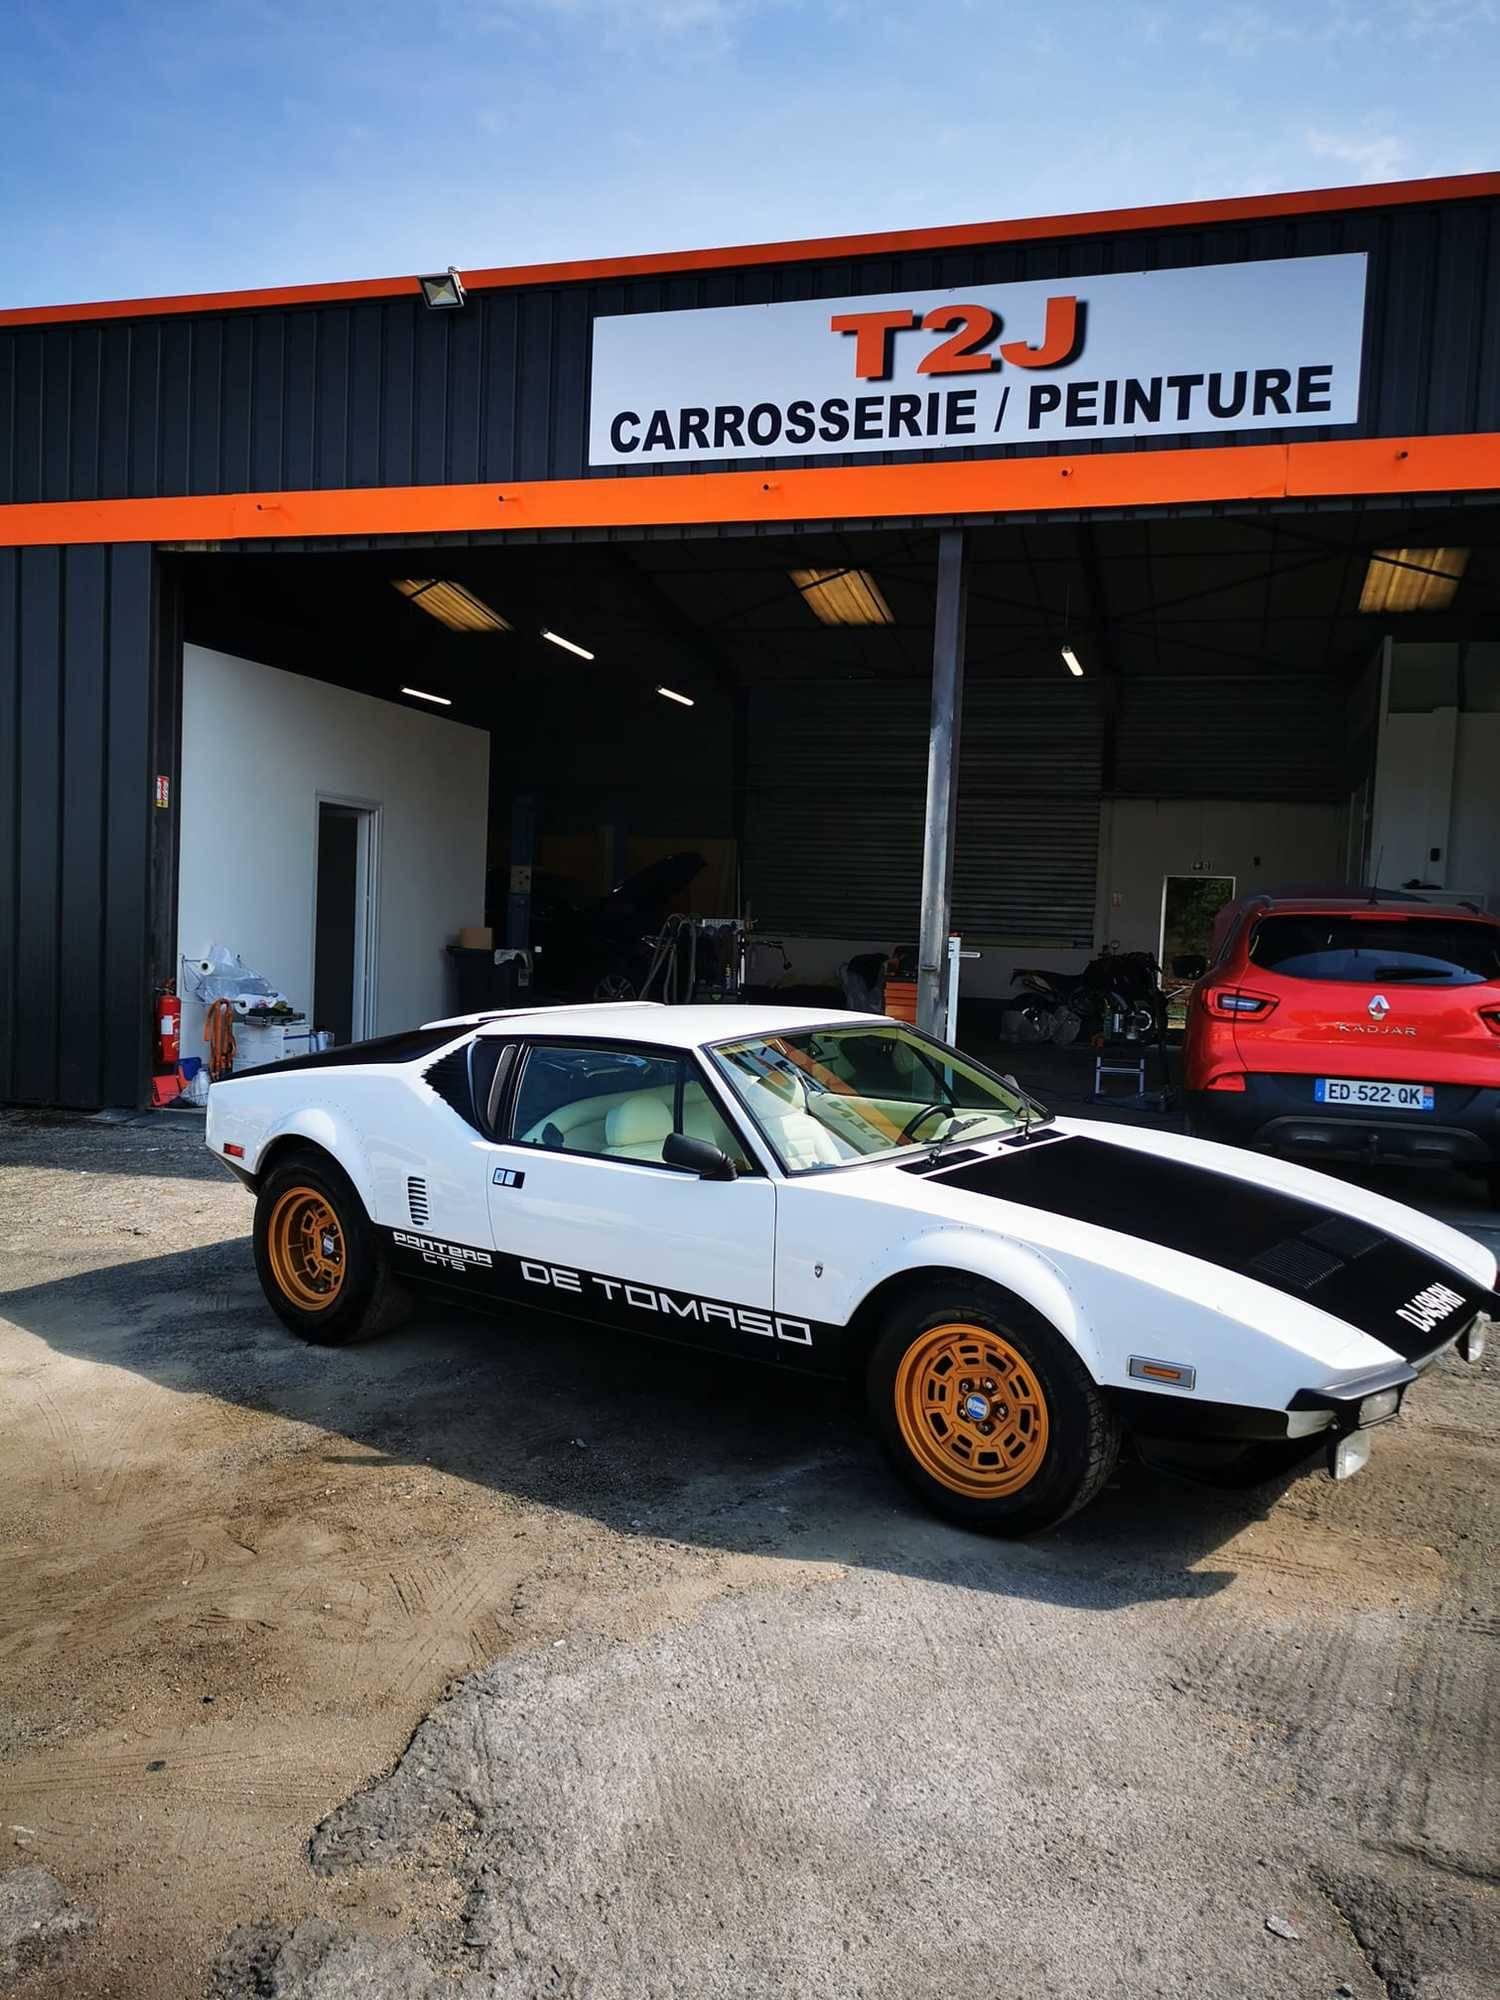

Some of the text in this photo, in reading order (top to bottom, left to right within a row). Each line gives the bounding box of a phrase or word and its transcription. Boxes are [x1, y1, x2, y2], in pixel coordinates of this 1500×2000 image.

[831, 296, 1086, 381] T2J
[611, 365, 1334, 454] CARROSSERIE / PEINTURE
[1338, 1022, 1417, 1036] KADJAR
[521, 1261, 814, 1346] DE TOMASO
